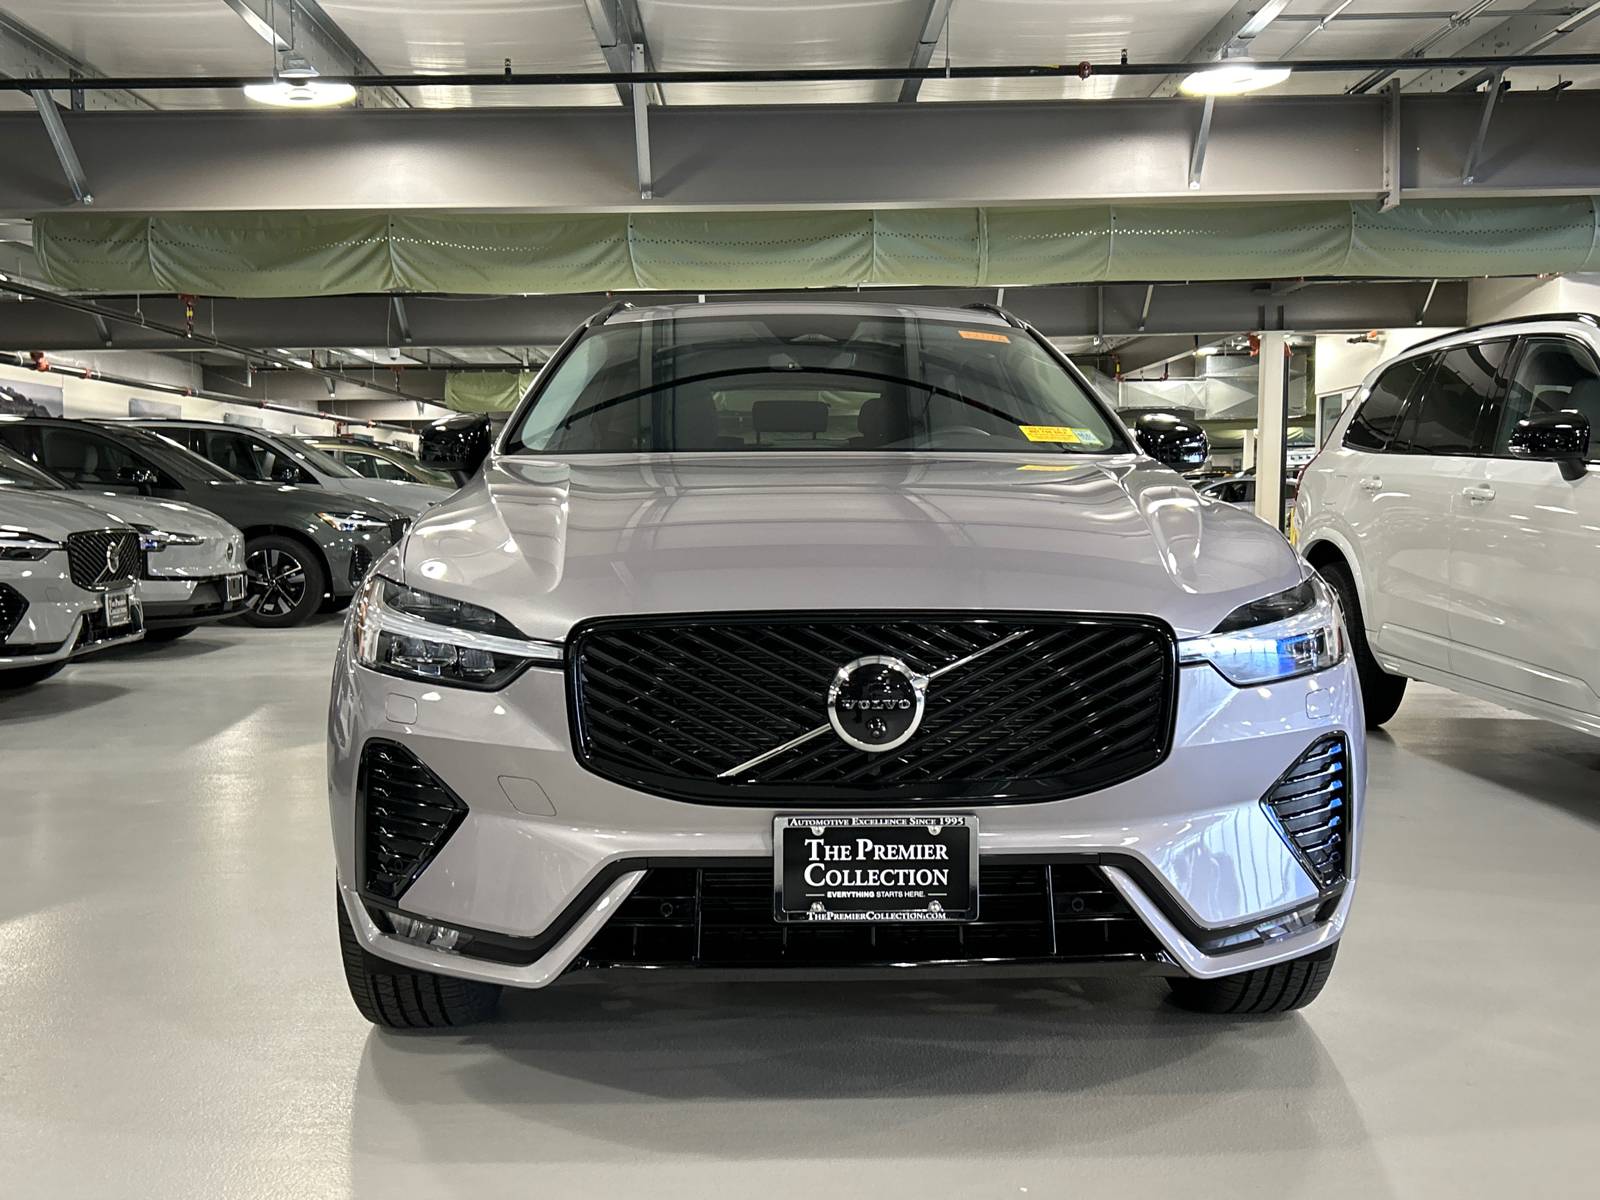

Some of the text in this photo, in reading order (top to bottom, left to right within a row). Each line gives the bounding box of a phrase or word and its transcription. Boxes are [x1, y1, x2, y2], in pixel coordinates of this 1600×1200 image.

[841, 699, 911, 710] VOLVO
[790, 817, 964, 826] AUTOMOTIVE EXCELLENCE SINCE 1995
[804, 838, 949, 861] THE PREMIER
[803, 862, 949, 887] COLLECTION
[826, 890, 926, 899] EVERYTHING STARTS HERE.
